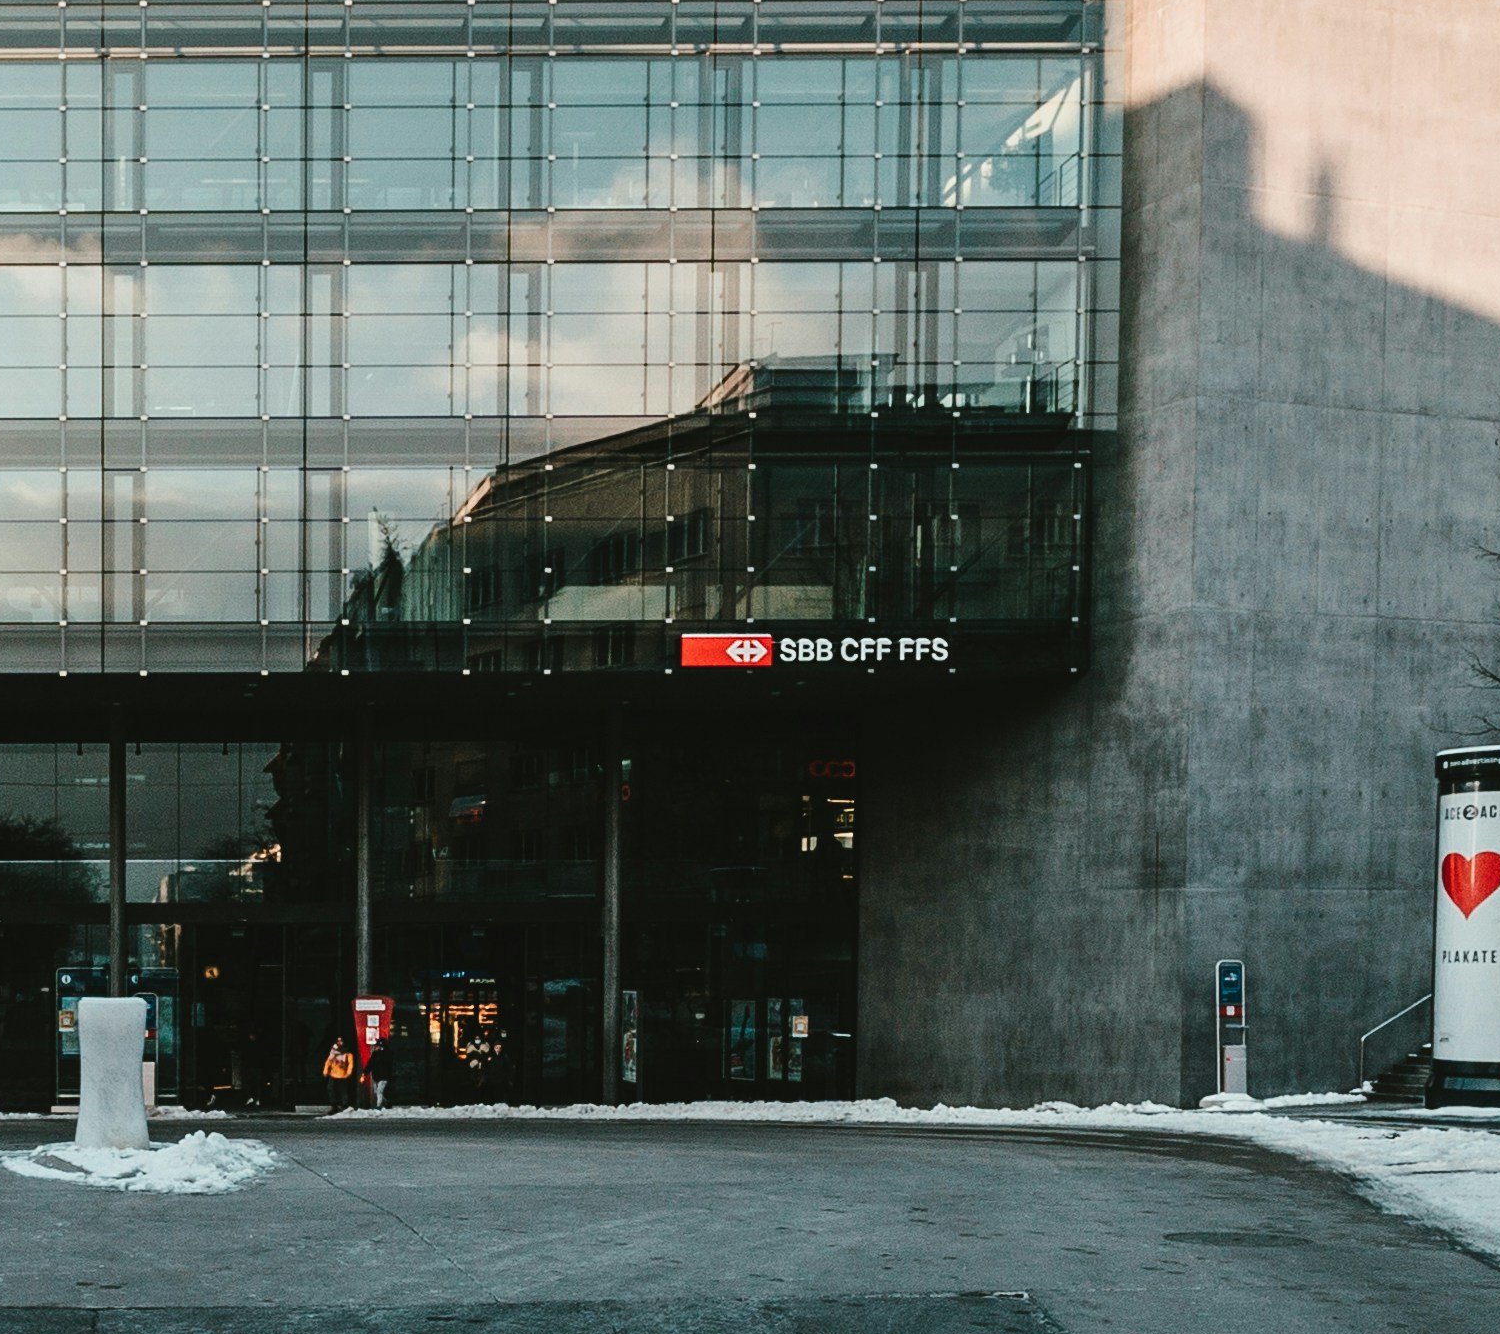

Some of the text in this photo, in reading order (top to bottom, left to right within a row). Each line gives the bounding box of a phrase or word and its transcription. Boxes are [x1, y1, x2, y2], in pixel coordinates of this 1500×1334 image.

[779, 638, 949, 662] SBB CFF FFS
[1442, 950, 1498, 964] PLAKATE
